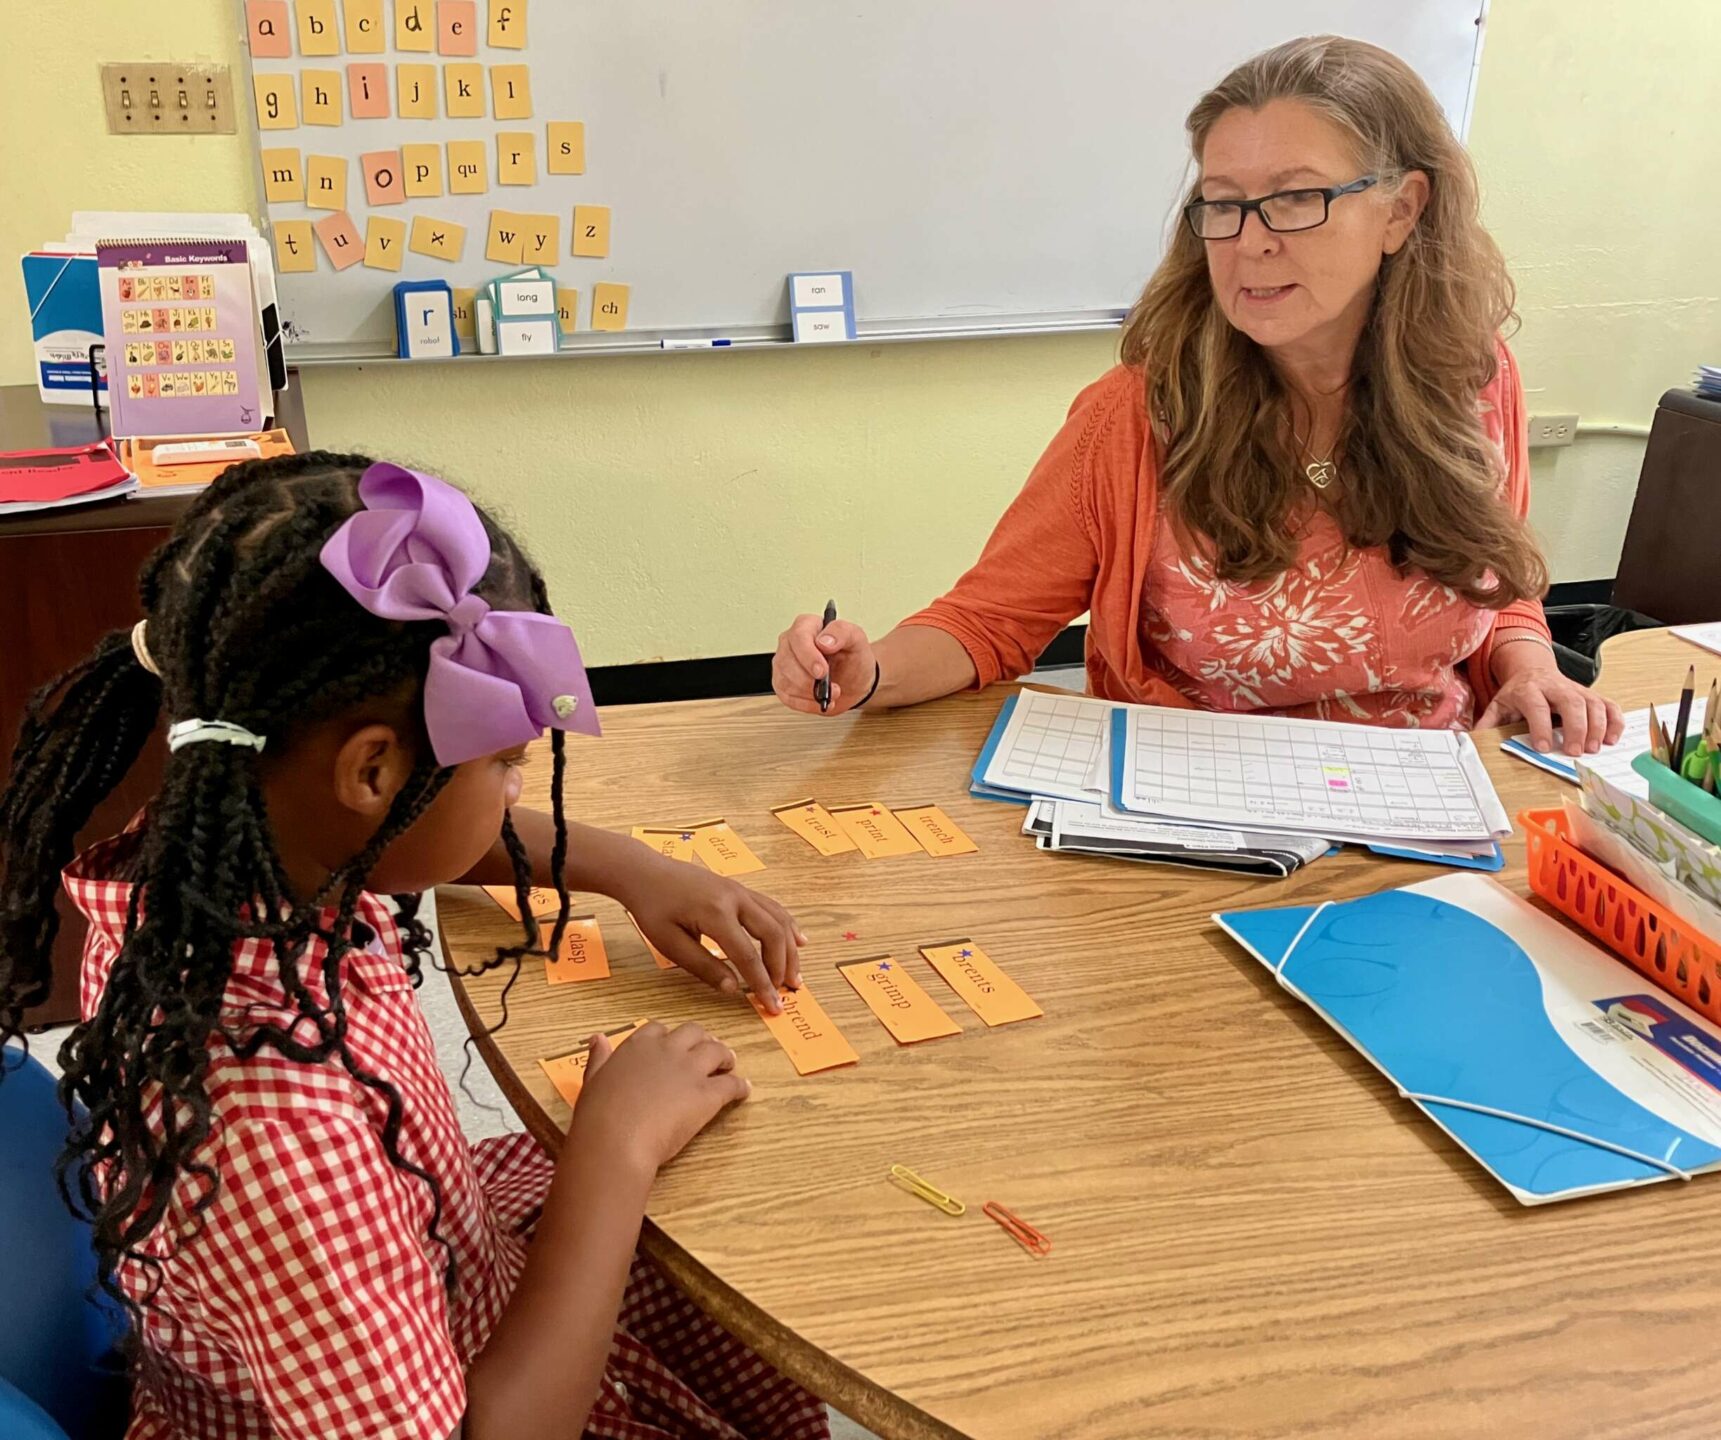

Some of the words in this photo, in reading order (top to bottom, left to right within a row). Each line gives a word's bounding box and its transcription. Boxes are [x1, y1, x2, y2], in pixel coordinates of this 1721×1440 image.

[258, 19, 275, 36] a
[309, 15, 324, 34] b
[358, 18, 370, 33] c
[405, 5, 423, 32] d
[451, 22, 462, 36] e
[496, 7, 512, 32] f
[265, 92, 279, 119] g
[315, 86, 328, 106] h
[361, 75, 369, 100] i
[411, 81, 419, 103] j
[458, 79, 472, 97] k
[507, 81, 514, 99] l
[272, 169, 294, 183] m
[320, 176, 333, 190] n
[374, 168, 393, 189] o
[415, 165, 429, 183] p
[457, 164, 477, 178] qu
[511, 152, 521, 165] r
[560, 142, 571, 155] s
[284, 233, 298, 255] t
[333, 234, 349, 248] u
[379, 237, 391, 251] v
[431, 231, 445, 246] x
[499, 230, 516, 244] w
[535, 234, 547, 252] y
[585, 225, 596, 238] z
[189, 254, 228, 264] Keywords
[516, 293, 538, 303] long
[601, 301, 618, 315] ch
[423, 309, 435, 327] r
[557, 306, 569, 319] h
[420, 337, 441, 345] robot
[521, 333, 532, 342] fly
[804, 815, 837, 839] trust
[856, 818, 888, 843] print
[919, 815, 955, 845] trench
[709, 836, 738, 860] draft
[569, 933, 587, 965] clasp
[952, 953, 995, 994] brents
[866, 971, 912, 1010] grimp
[781, 994, 822, 1041] shrend
